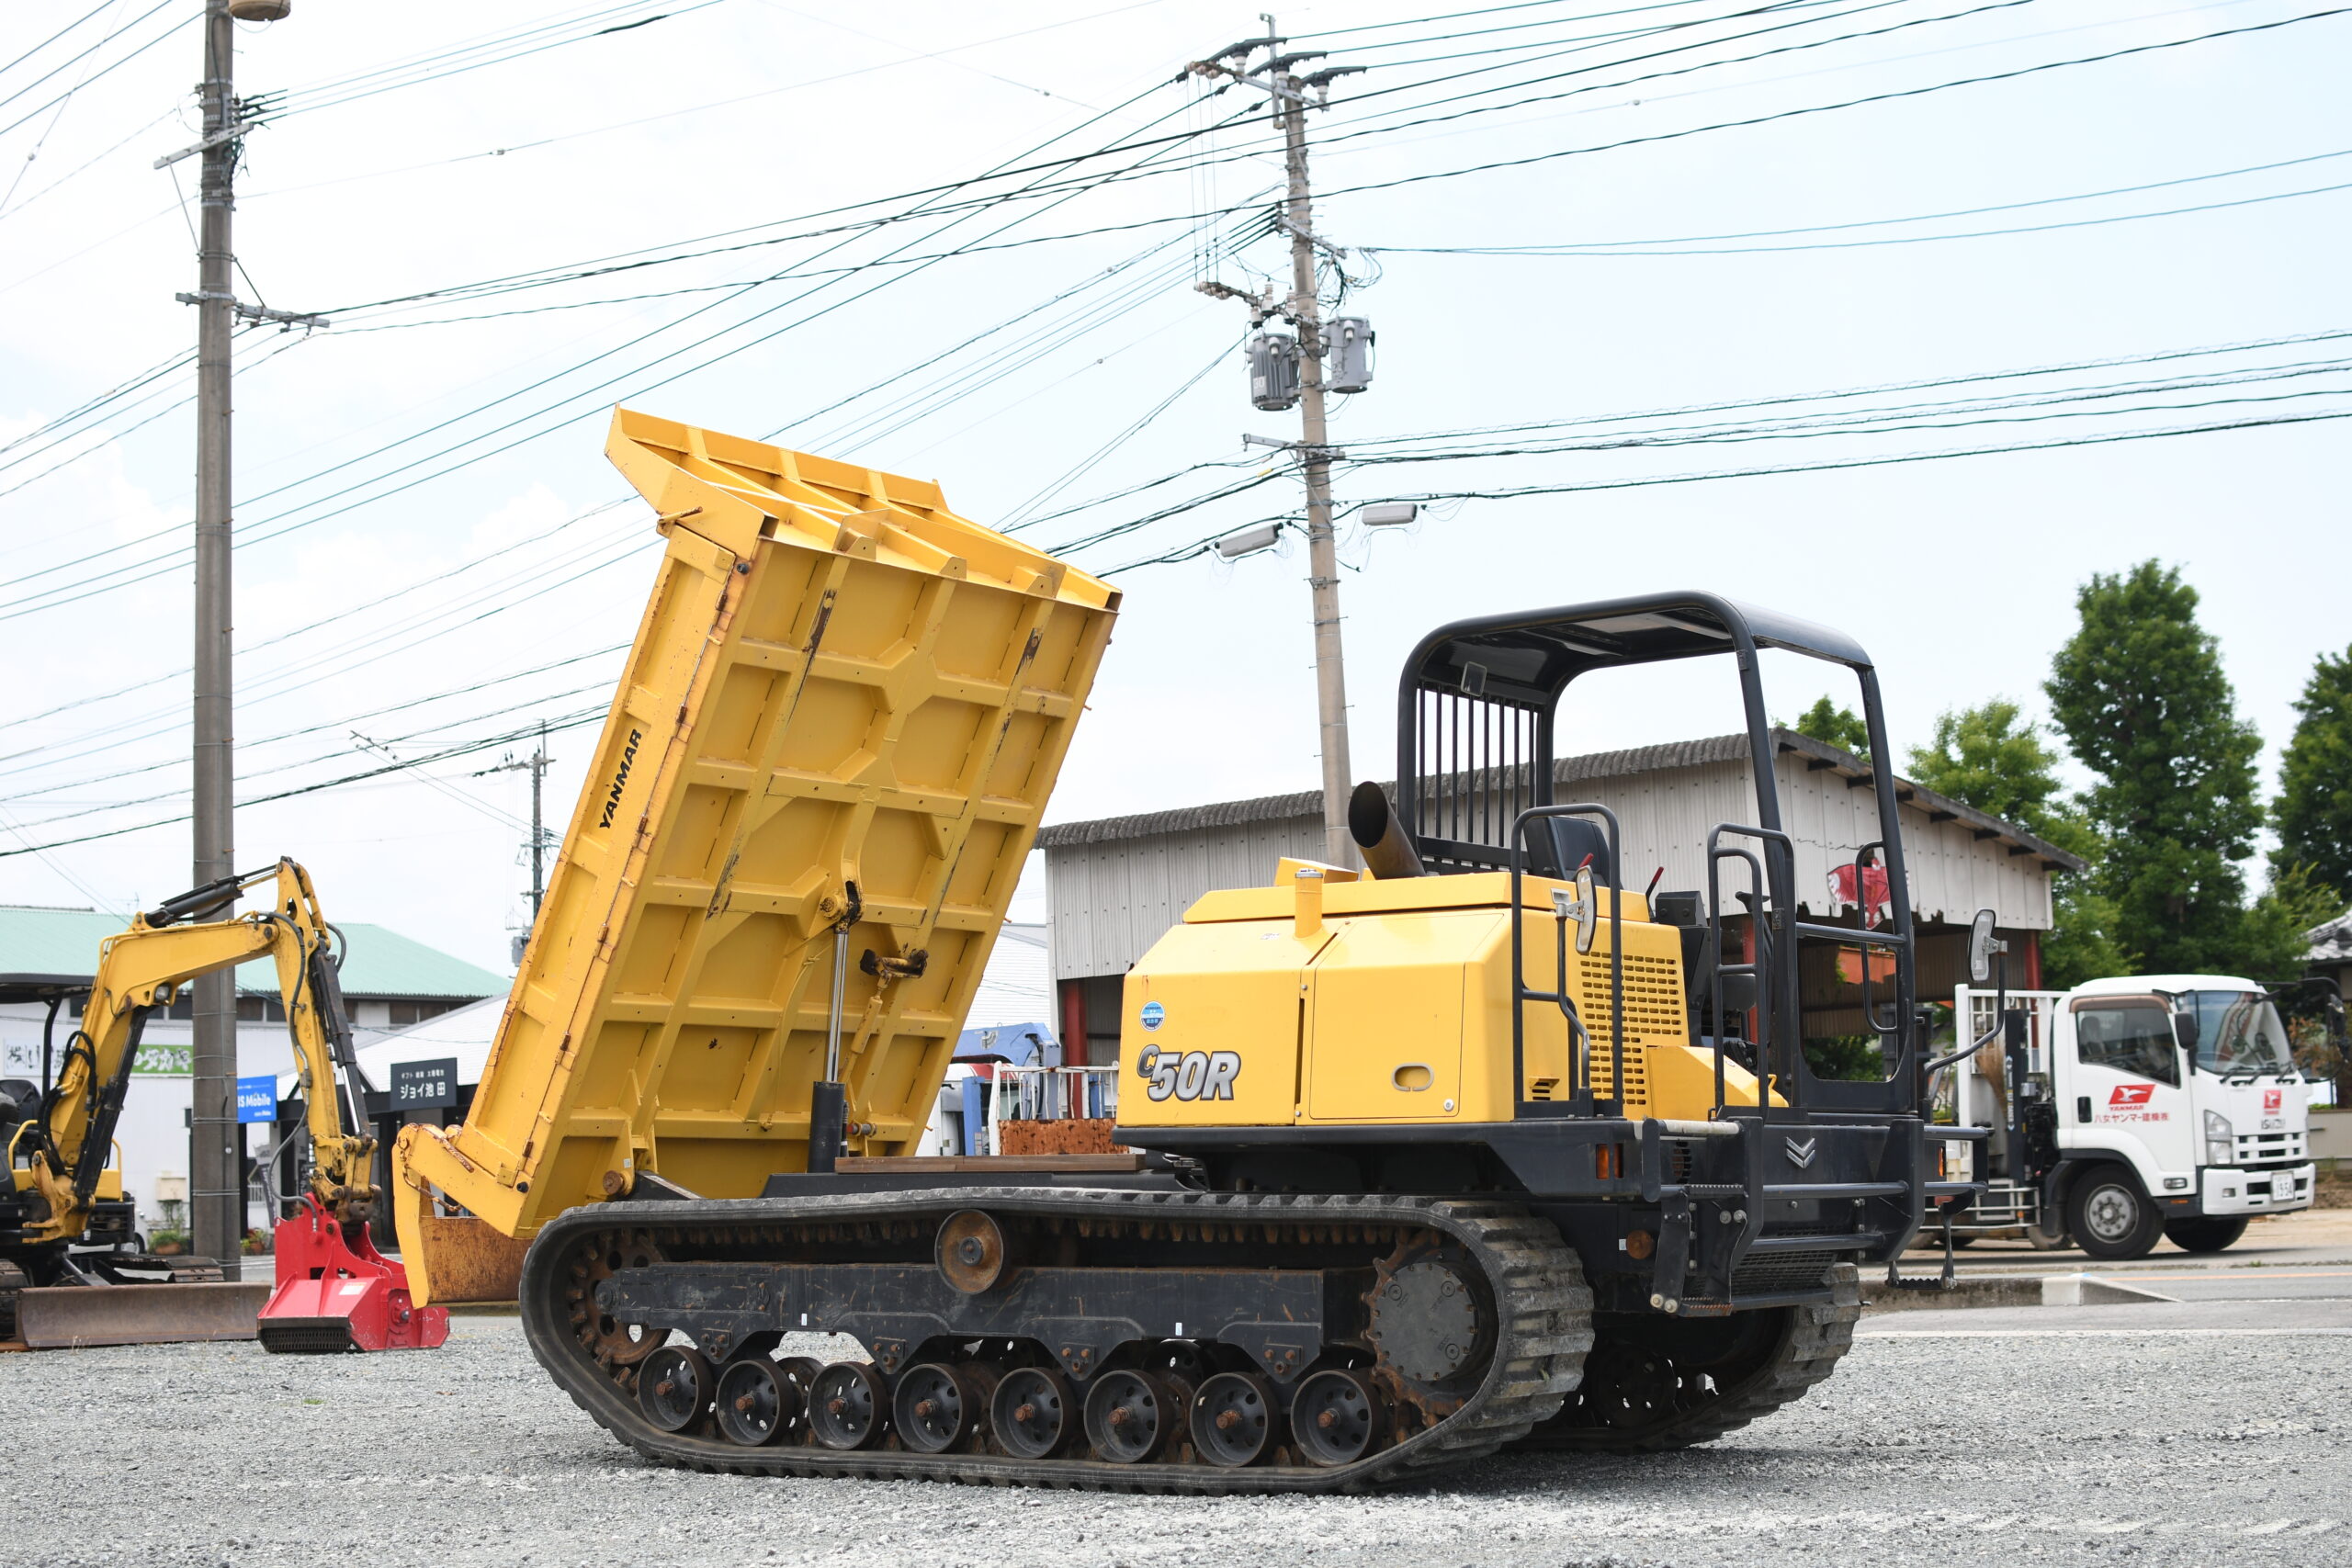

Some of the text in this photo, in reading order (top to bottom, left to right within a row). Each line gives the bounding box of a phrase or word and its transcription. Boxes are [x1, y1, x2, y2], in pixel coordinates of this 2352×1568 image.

[599, 728, 642, 829] YANMAR
[245, 1093, 272, 1108] Mobile
[1137, 1044, 1241, 1101] C50R
